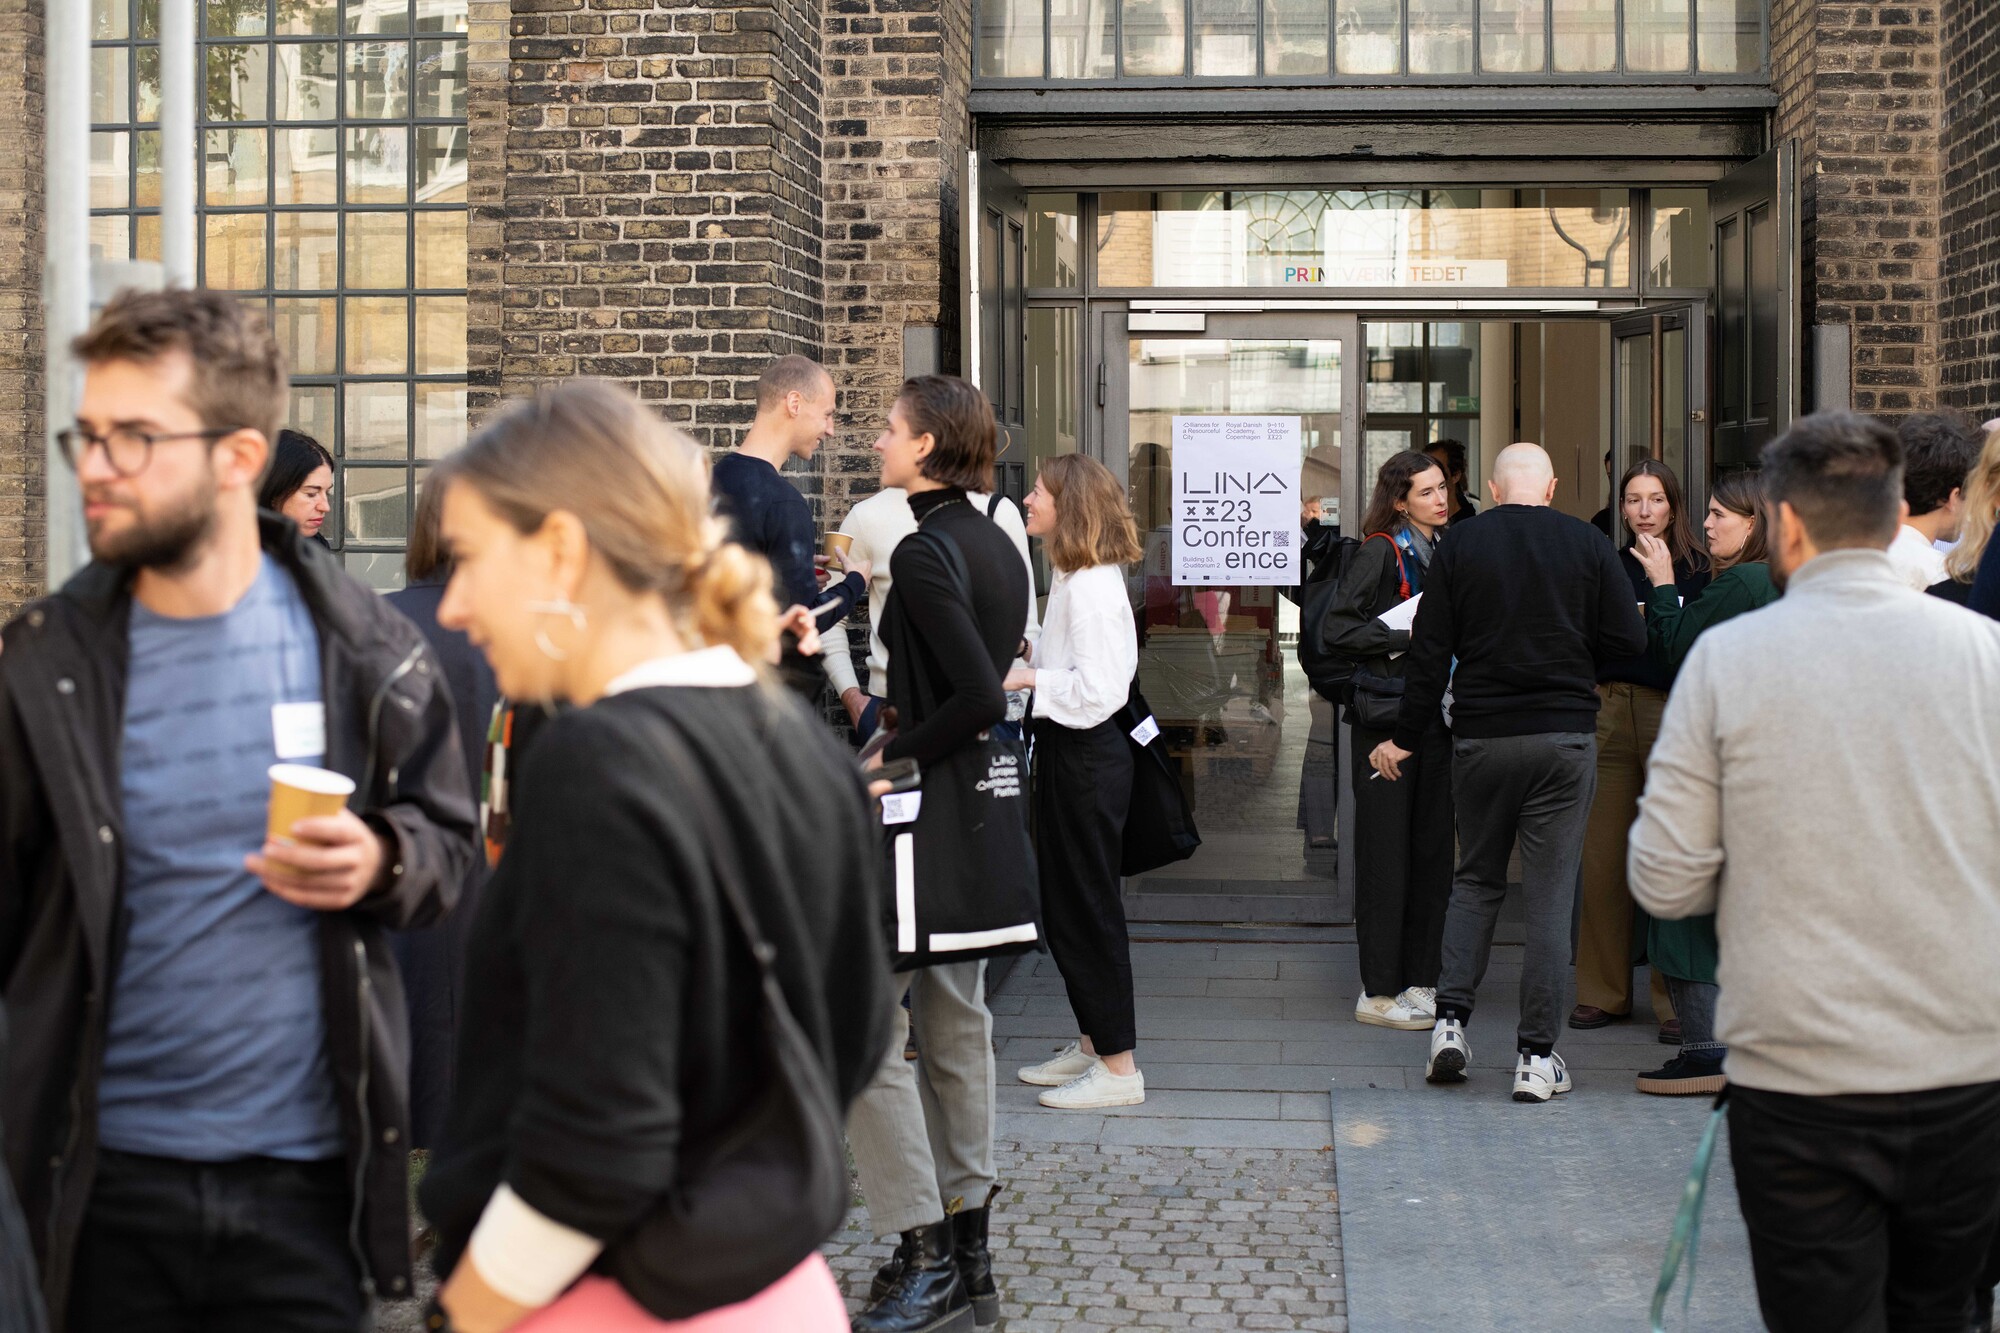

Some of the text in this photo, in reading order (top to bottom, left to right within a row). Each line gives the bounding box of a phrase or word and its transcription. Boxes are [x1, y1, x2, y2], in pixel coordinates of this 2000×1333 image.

[1183, 472, 1288, 494] LINA
[1182, 524, 1271, 548] Confer
[1225, 552, 1288, 568] ence
